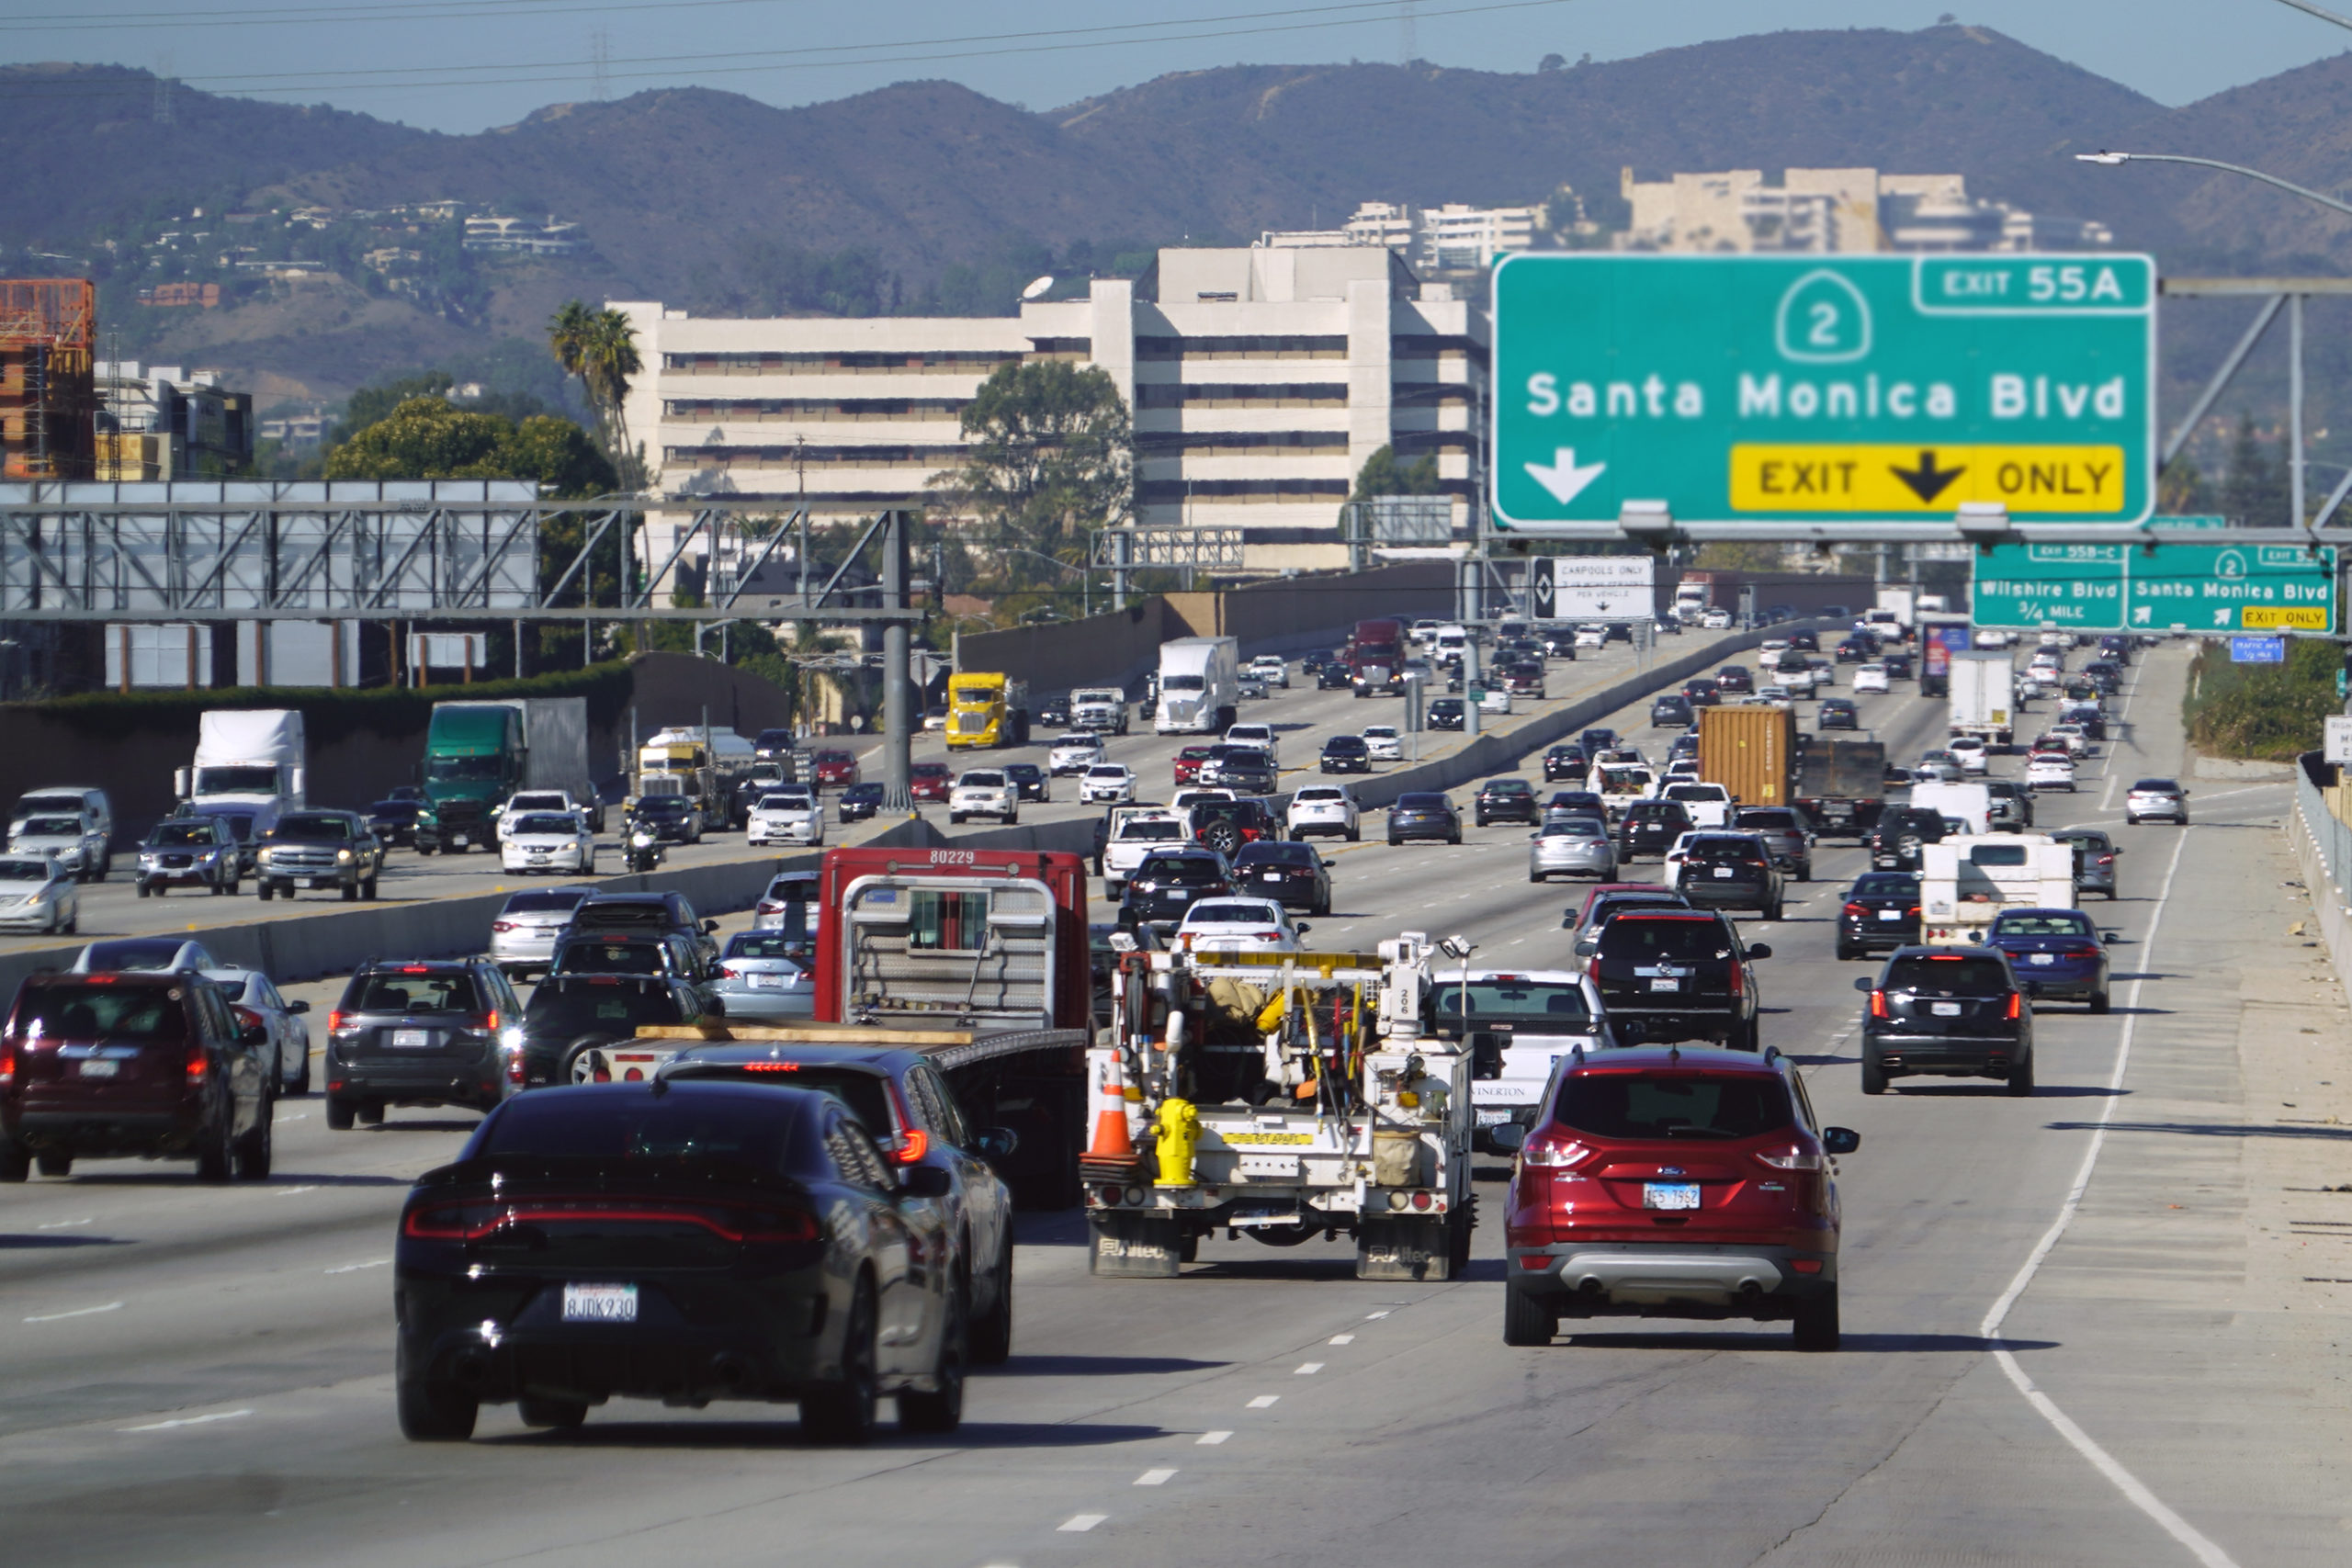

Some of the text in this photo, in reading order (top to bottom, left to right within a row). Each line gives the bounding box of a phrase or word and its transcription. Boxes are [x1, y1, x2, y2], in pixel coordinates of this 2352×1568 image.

[1943, 267, 2123, 300] EXIT 55A
[1808, 303, 1838, 345] 2
[1526, 372, 2125, 419] Santa Monica Blvd
[1759, 461, 2111, 496] EXIT ONLY
[2041, 546, 2116, 558] EXIT 55B-C
[2267, 550, 2326, 561] EXIT 5A
[1562, 566, 1643, 575] CARPOOLS ONLY
[2226, 559, 2236, 575] 2
[1981, 581, 2118, 597] Wilshire Blvd
[2135, 581, 2327, 600] Santa Monica Blvd
[2050, 605, 2085, 618] MILE
[2245, 612, 2323, 624] EXIT ONLY
[930, 851, 975, 864] 80229
[1400, 988, 1408, 1015] 206
[1388, 1247, 1432, 1263] Altec
